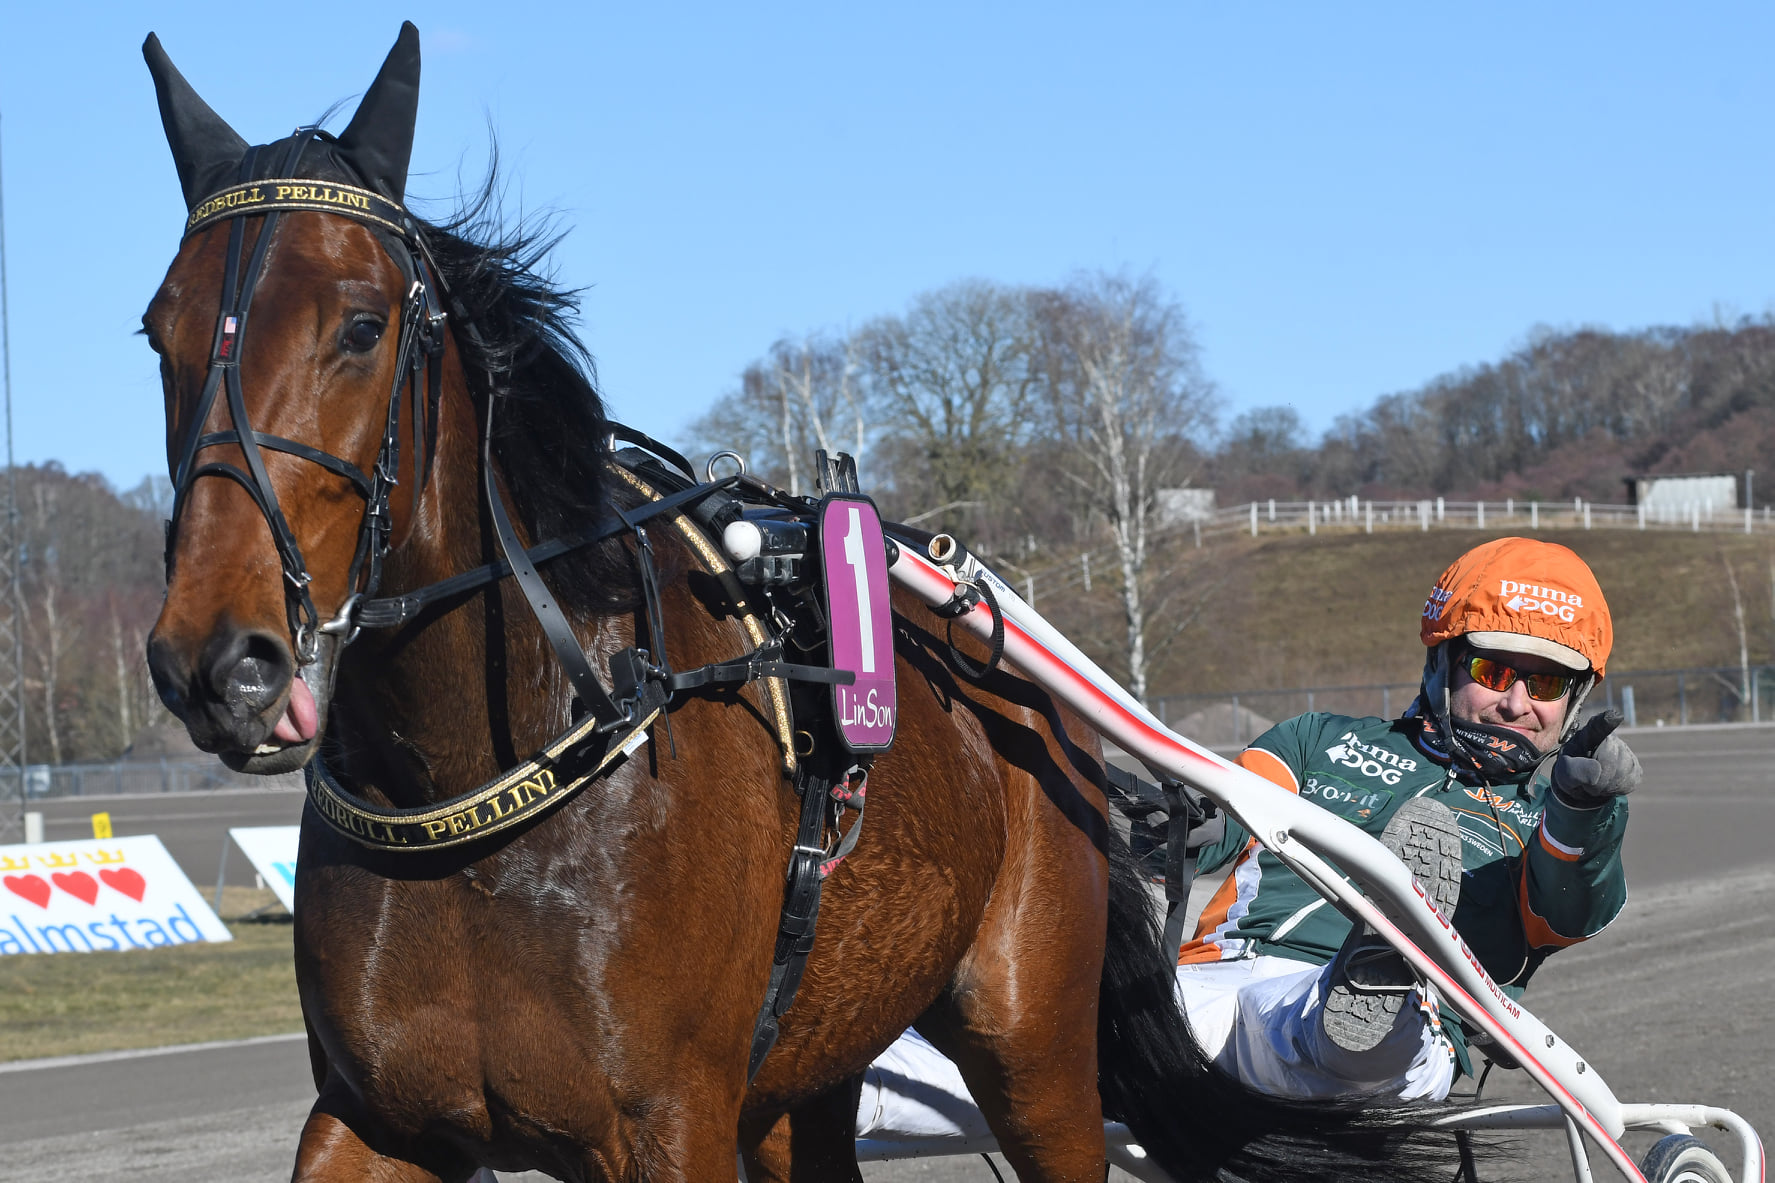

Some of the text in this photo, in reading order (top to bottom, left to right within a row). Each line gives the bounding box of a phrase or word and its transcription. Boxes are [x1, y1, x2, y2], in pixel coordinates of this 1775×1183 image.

[275, 186, 371, 210] PELLINI
[843, 508, 875, 673] 1
[1499, 579, 1584, 608] prima
[1522, 597, 1576, 622] DOG
[841, 688, 892, 728] LinSon
[1341, 752, 1403, 786] DOG
[1467, 837, 1494, 857] SWEDEN
[1484, 974, 1521, 1020] MULTICAM
